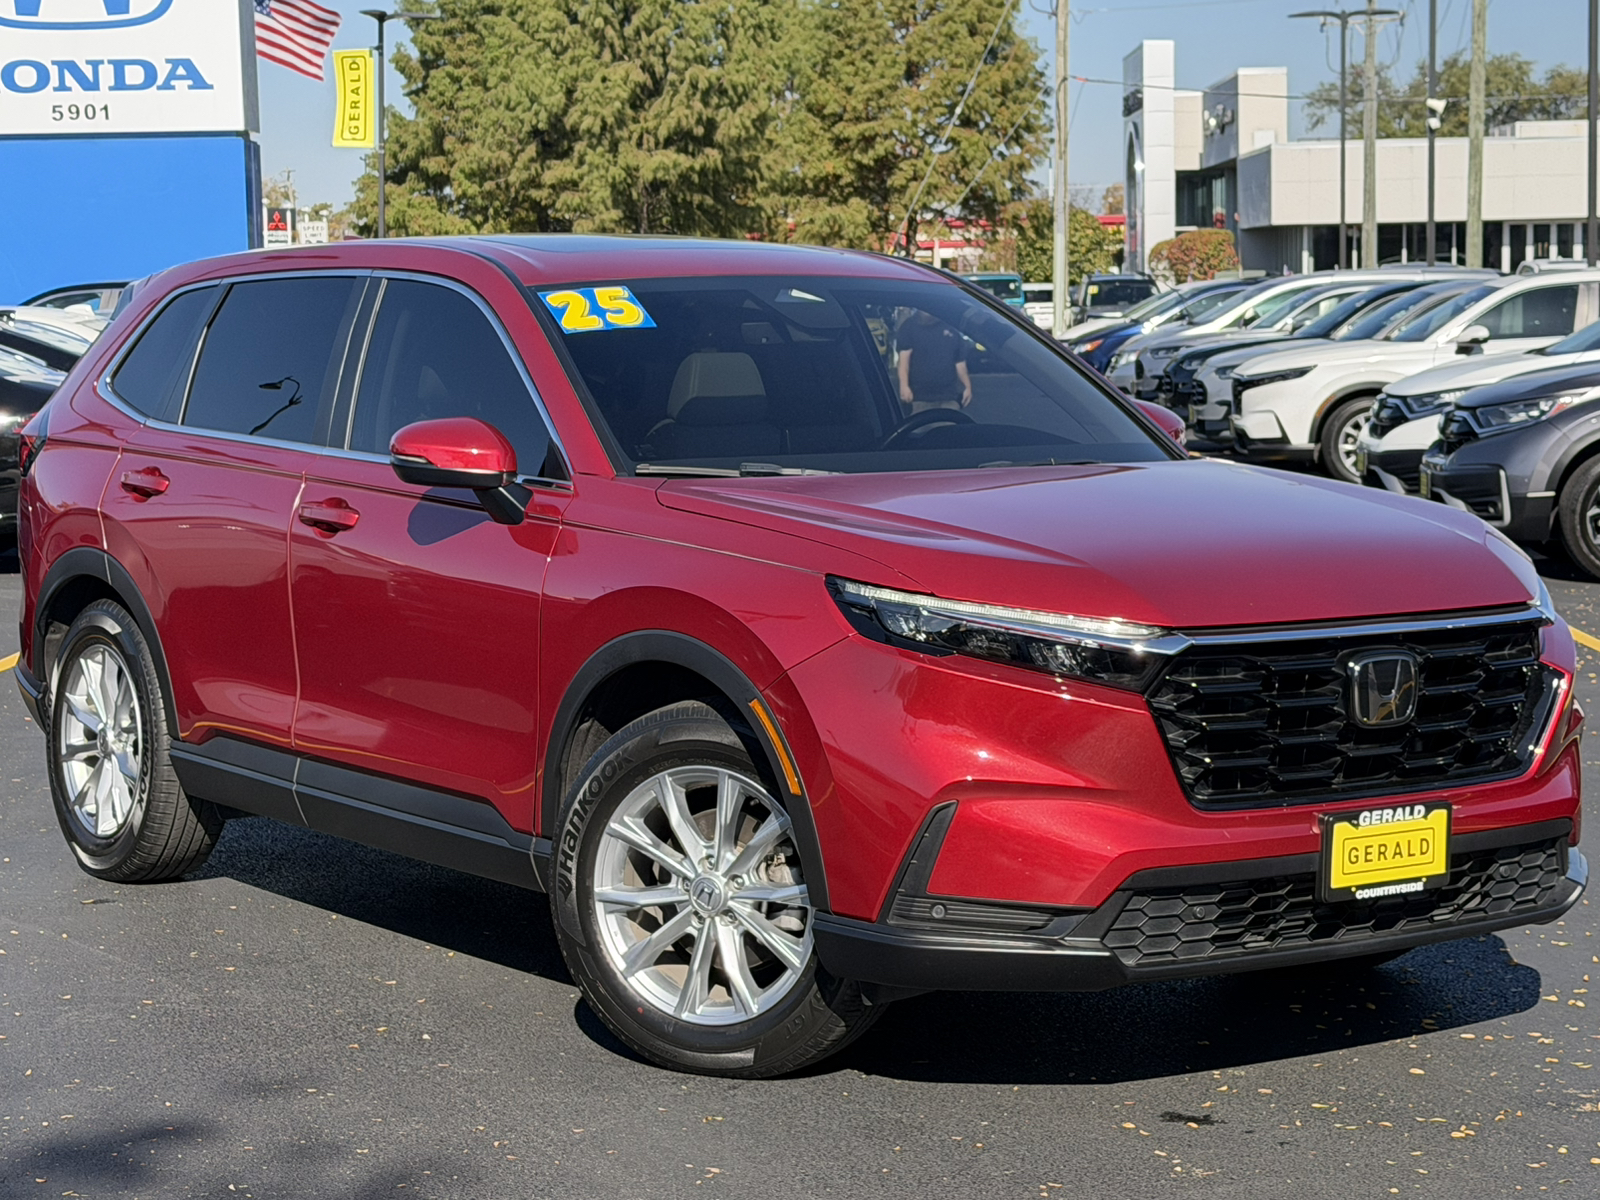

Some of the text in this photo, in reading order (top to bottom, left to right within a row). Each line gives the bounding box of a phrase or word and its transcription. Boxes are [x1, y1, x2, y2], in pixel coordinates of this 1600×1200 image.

[0, 58, 214, 94] ONDA
[348, 60, 361, 135] GERALD
[51, 103, 110, 121] 5901
[546, 286, 645, 331] 25
[1358, 804, 1426, 827] GERALD
[1347, 837, 1431, 865] GERALD
[1355, 881, 1425, 900] COUNTRYSIDE
